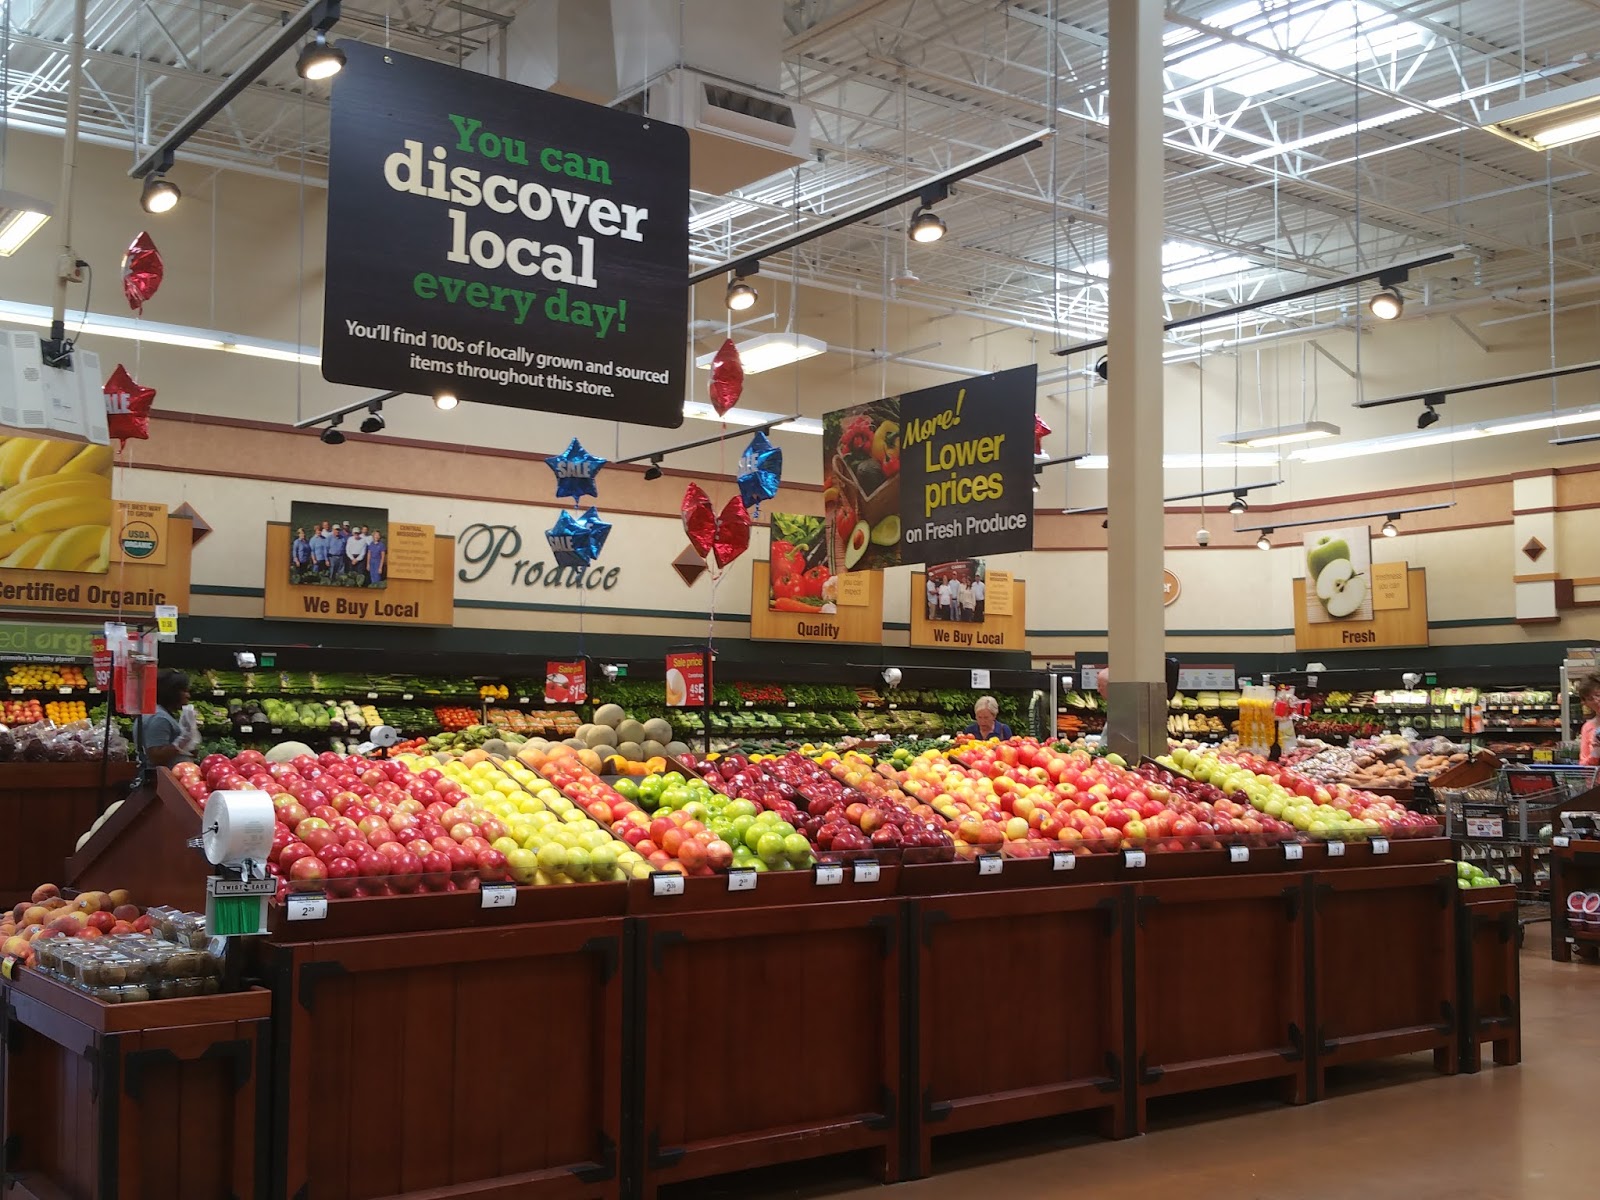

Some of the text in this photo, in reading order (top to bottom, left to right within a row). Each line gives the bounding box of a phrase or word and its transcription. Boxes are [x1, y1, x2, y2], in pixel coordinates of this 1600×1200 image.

[449, 113, 613, 185] You can
[384, 139, 648, 242] discover
[447, 208, 598, 288] local
[413, 271, 627, 338] every day!
[345, 319, 669, 385] You'll find 100s of locally grown and sourced
[409, 353, 615, 398] items throughout this store.
[104, 394, 132, 414] ALE
[902, 388, 966, 449] More!
[557, 461, 591, 478] SALE
[925, 434, 1005, 473] Lower
[925, 471, 1004, 517] prices
[128, 530, 150, 538] USDA
[548, 536, 575, 552] SALE
[906, 512, 1027, 544] on Fresh Produce
[458, 523, 621, 590] Produce
[87, 585, 166, 608] Organic
[303, 595, 419, 619] We Buy Local
[797, 621, 840, 640] Quality
[934, 628, 1004, 646] We Buy Local
[1341, 629, 1376, 644] Fresh
[673, 658, 703, 668] Sale price
